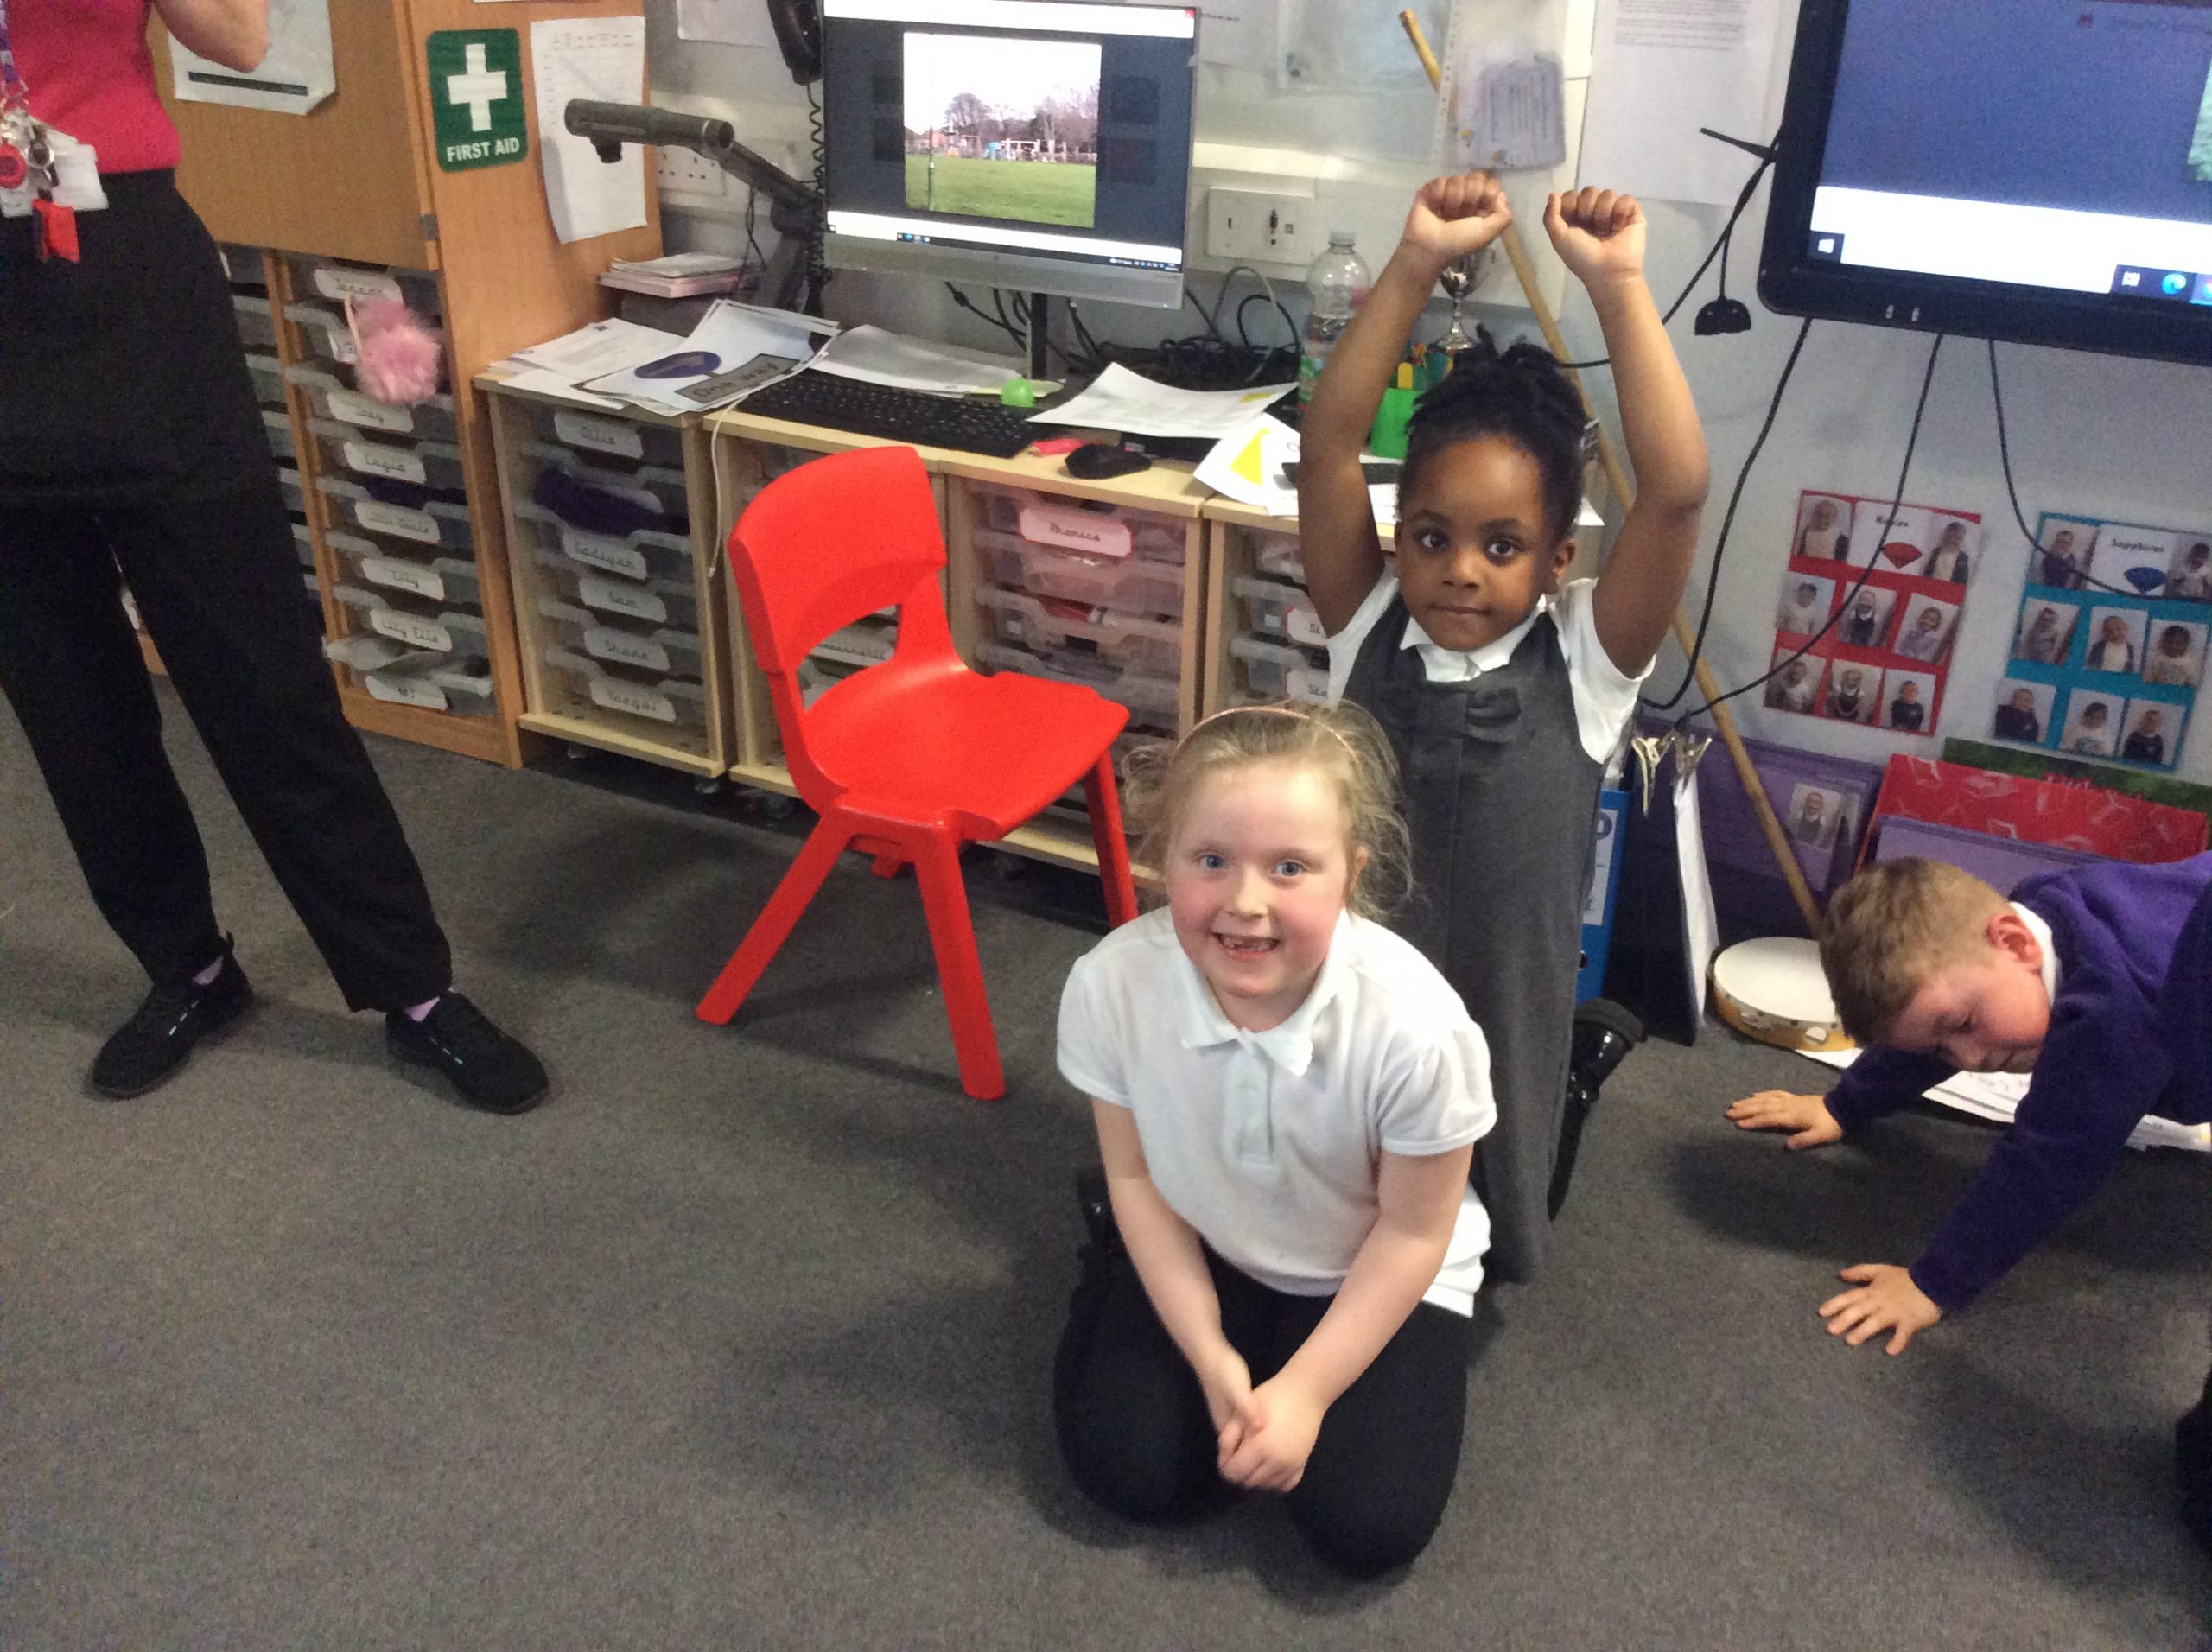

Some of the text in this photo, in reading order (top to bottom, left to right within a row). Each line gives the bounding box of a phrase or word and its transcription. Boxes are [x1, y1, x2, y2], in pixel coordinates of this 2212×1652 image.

[446, 137, 520, 162] FIRST AID
[692, 380, 734, 398] One
